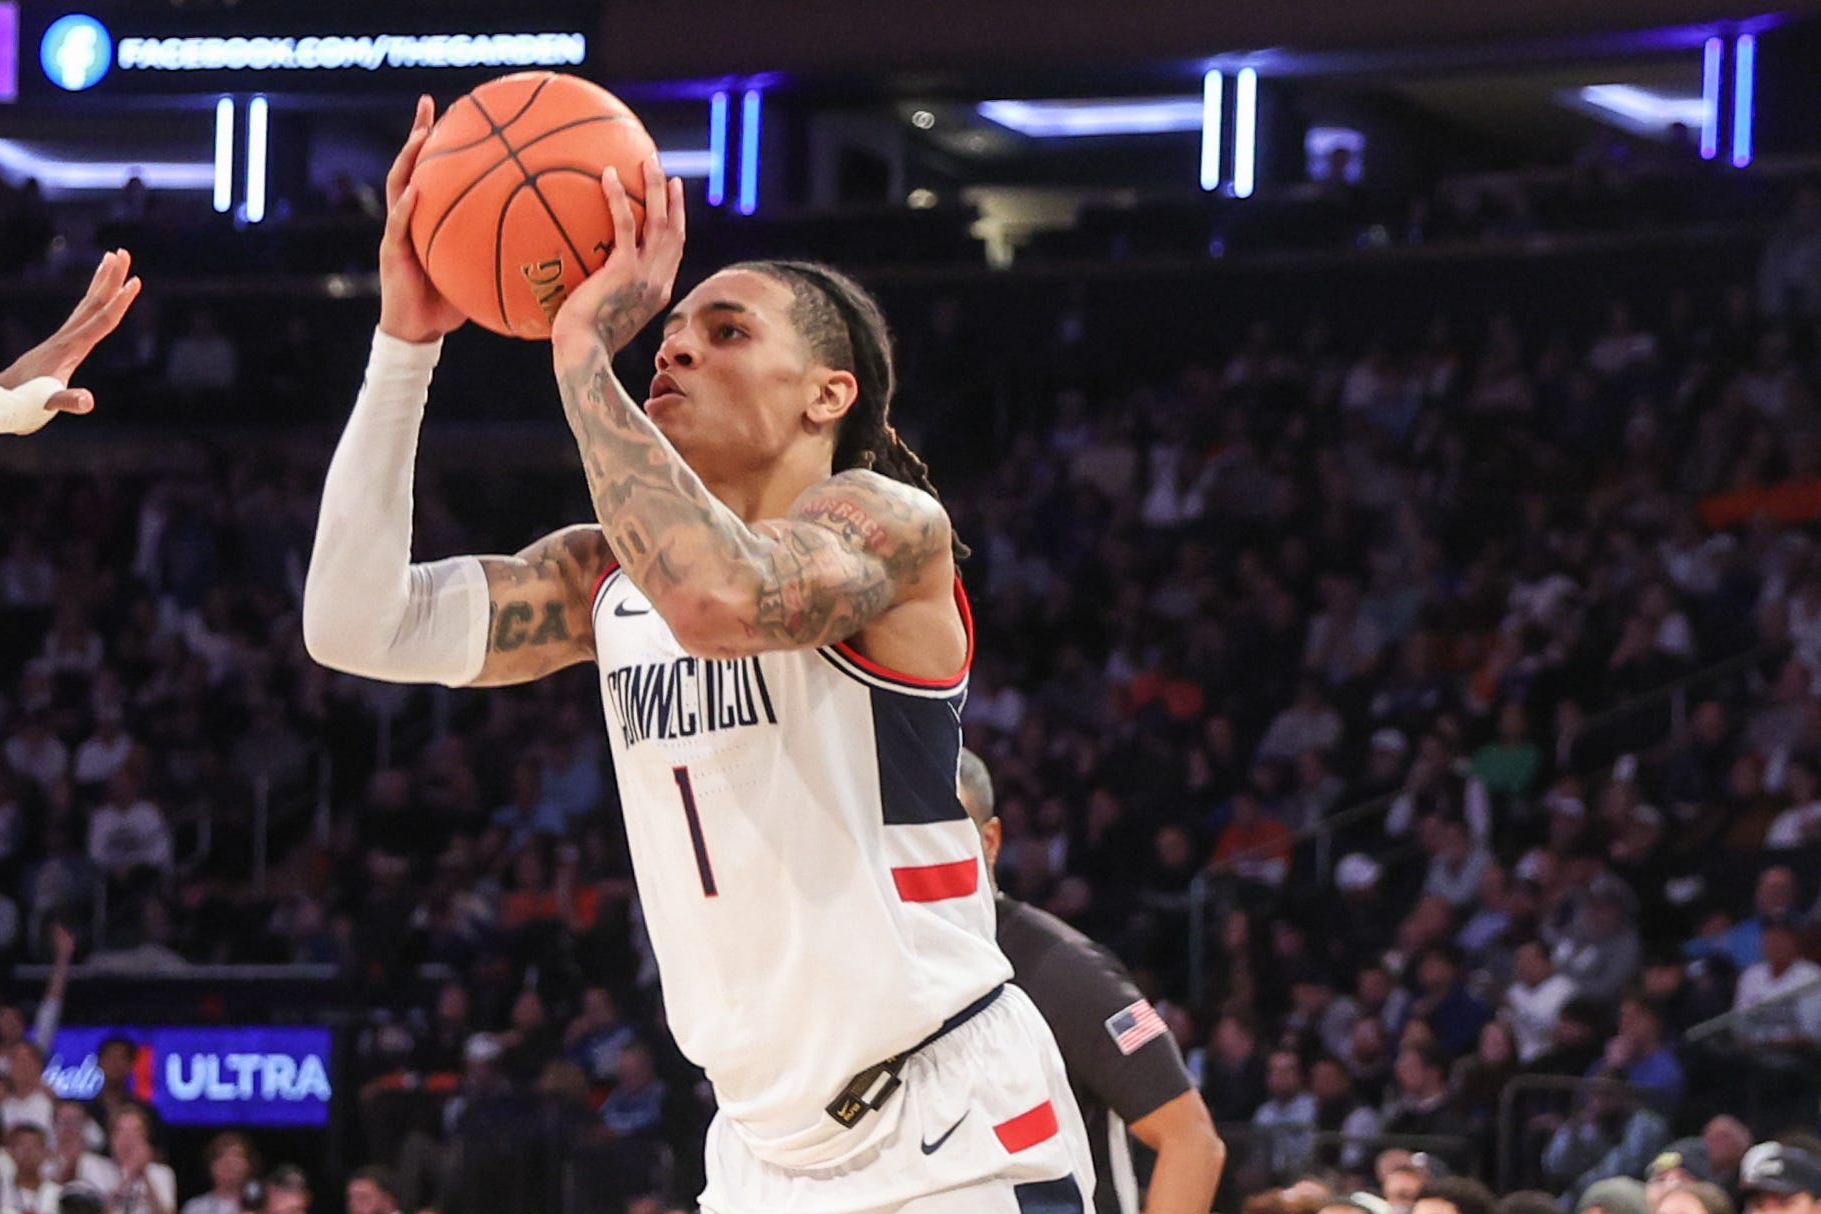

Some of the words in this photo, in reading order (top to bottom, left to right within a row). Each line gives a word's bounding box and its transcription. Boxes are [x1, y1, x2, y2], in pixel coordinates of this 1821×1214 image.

[118, 33, 585, 70] FACEBOOK.COM/THEGARDEN
[672, 765, 719, 898] 1
[165, 1052, 332, 1100] ULTRA
